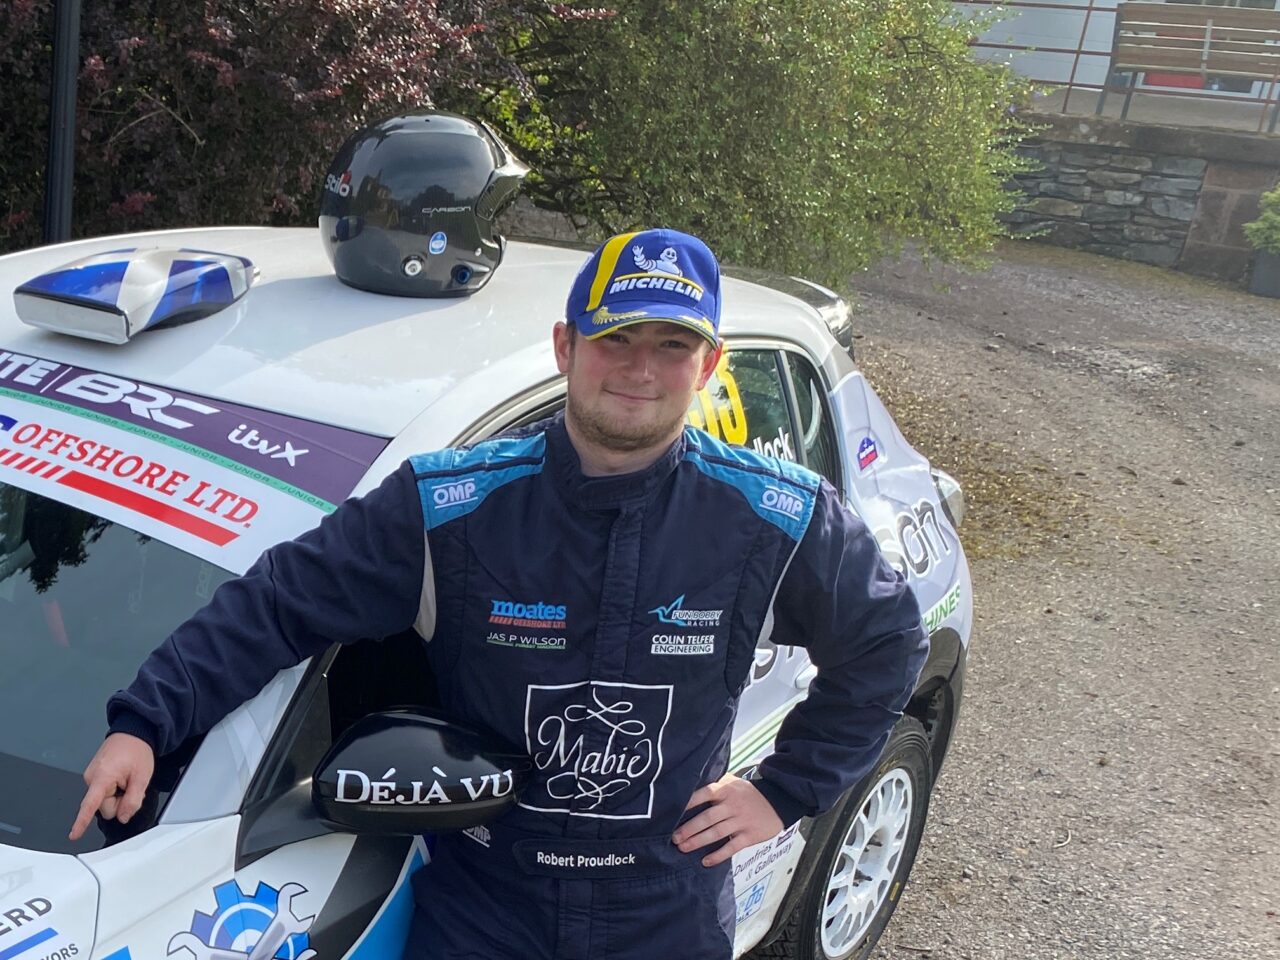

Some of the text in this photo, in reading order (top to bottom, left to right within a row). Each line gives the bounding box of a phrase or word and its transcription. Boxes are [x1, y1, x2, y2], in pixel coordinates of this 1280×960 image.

[422, 205, 471, 217] CARBON
[609, 277, 703, 302] MICHELIN
[55, 372, 221, 429] BRC
[12, 421, 190, 496] OFFSHORE
[35, 398, 71, 412] JUNIOR
[81, 410, 119, 426] JUNIOR
[127, 425, 168, 443] JUNIOR
[176, 442, 218, 462] JUNIOR
[228, 462, 272, 483] JUNIOR
[280, 484, 326, 508] JUNIOR
[433, 480, 476, 504] OMP
[761, 490, 803, 515] OMP
[490, 599, 567, 620] moates
[672, 609, 723, 620] FUN BOBBY
[486, 632, 506, 642] JAS
[509, 634, 517, 643] P
[652, 634, 715, 645] COLIN TELFER
[653, 644, 711, 653] ENGINEERING
[535, 712, 652, 780] Mabie
[536, 851, 637, 868] Robert Proudlock
[734, 842, 773, 876] Dumfries
[754, 841, 794, 875] Galloway
